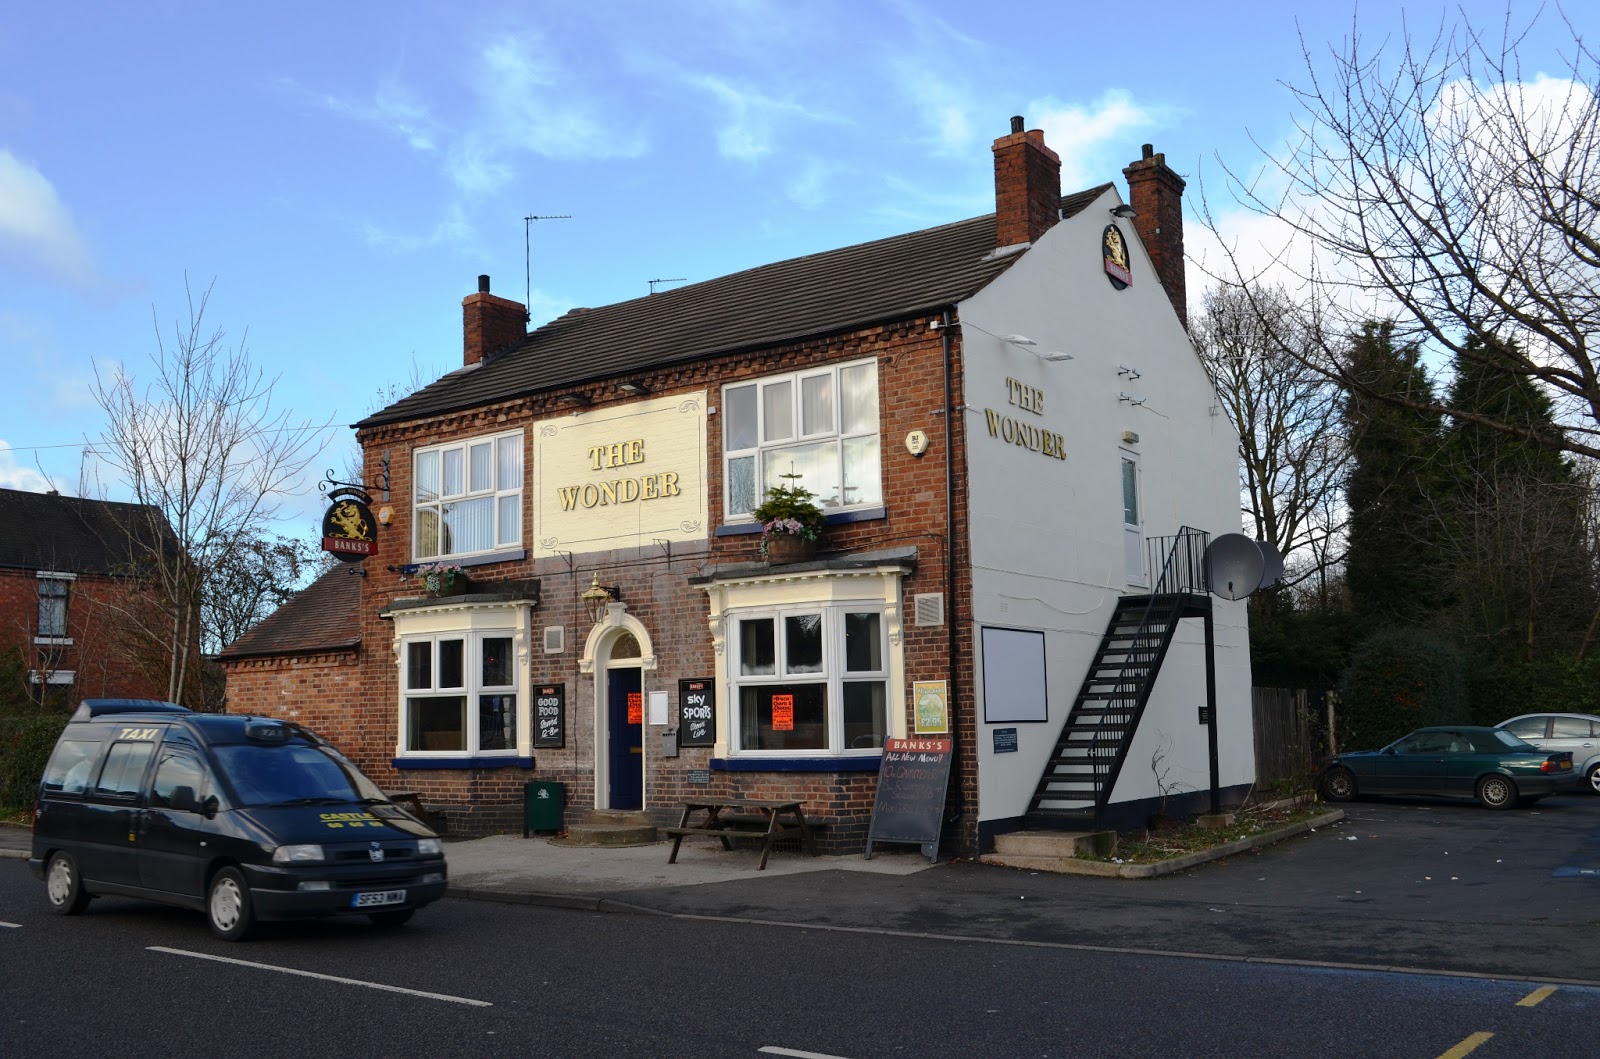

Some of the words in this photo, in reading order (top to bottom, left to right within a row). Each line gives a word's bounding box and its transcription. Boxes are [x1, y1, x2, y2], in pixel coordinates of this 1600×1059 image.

[1006, 376, 1044, 416] THE
[985, 408, 1067, 460] WONDER
[588, 439, 644, 470] THE
[558, 472, 681, 511] WONDER
[334, 540, 370, 552] BANKS'S
[538, 698, 558, 706] GOOD
[687, 694, 705, 706] sky
[538, 707, 559, 716] FOOD
[683, 705, 711, 719] SPORTS
[920, 717, 943, 727] £2.95
[119, 728, 160, 740] TAXI
[894, 741, 942, 750] BANKS'S
